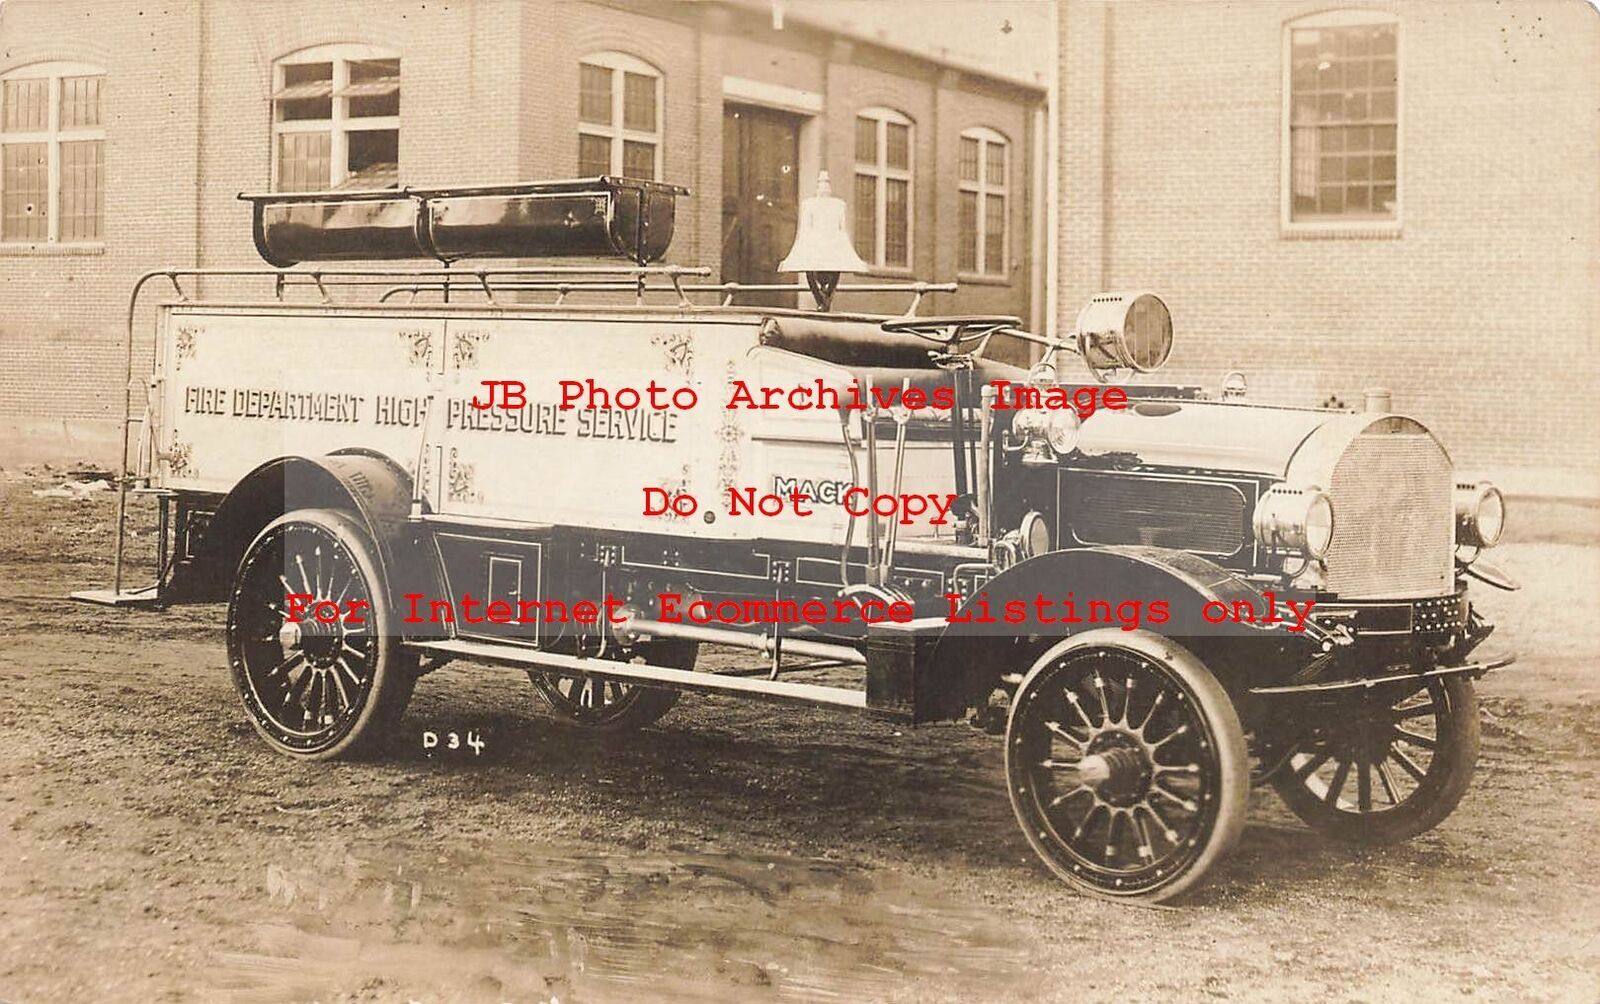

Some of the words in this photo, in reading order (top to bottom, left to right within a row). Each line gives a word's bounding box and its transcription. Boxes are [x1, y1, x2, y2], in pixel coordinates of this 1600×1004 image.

[185, 386, 226, 415] FIRE
[232, 388, 364, 423] DEPARTMENT
[446, 398, 567, 436] PRESSURE
[577, 405, 678, 444] SERVICE
[774, 476, 855, 506] MACK
